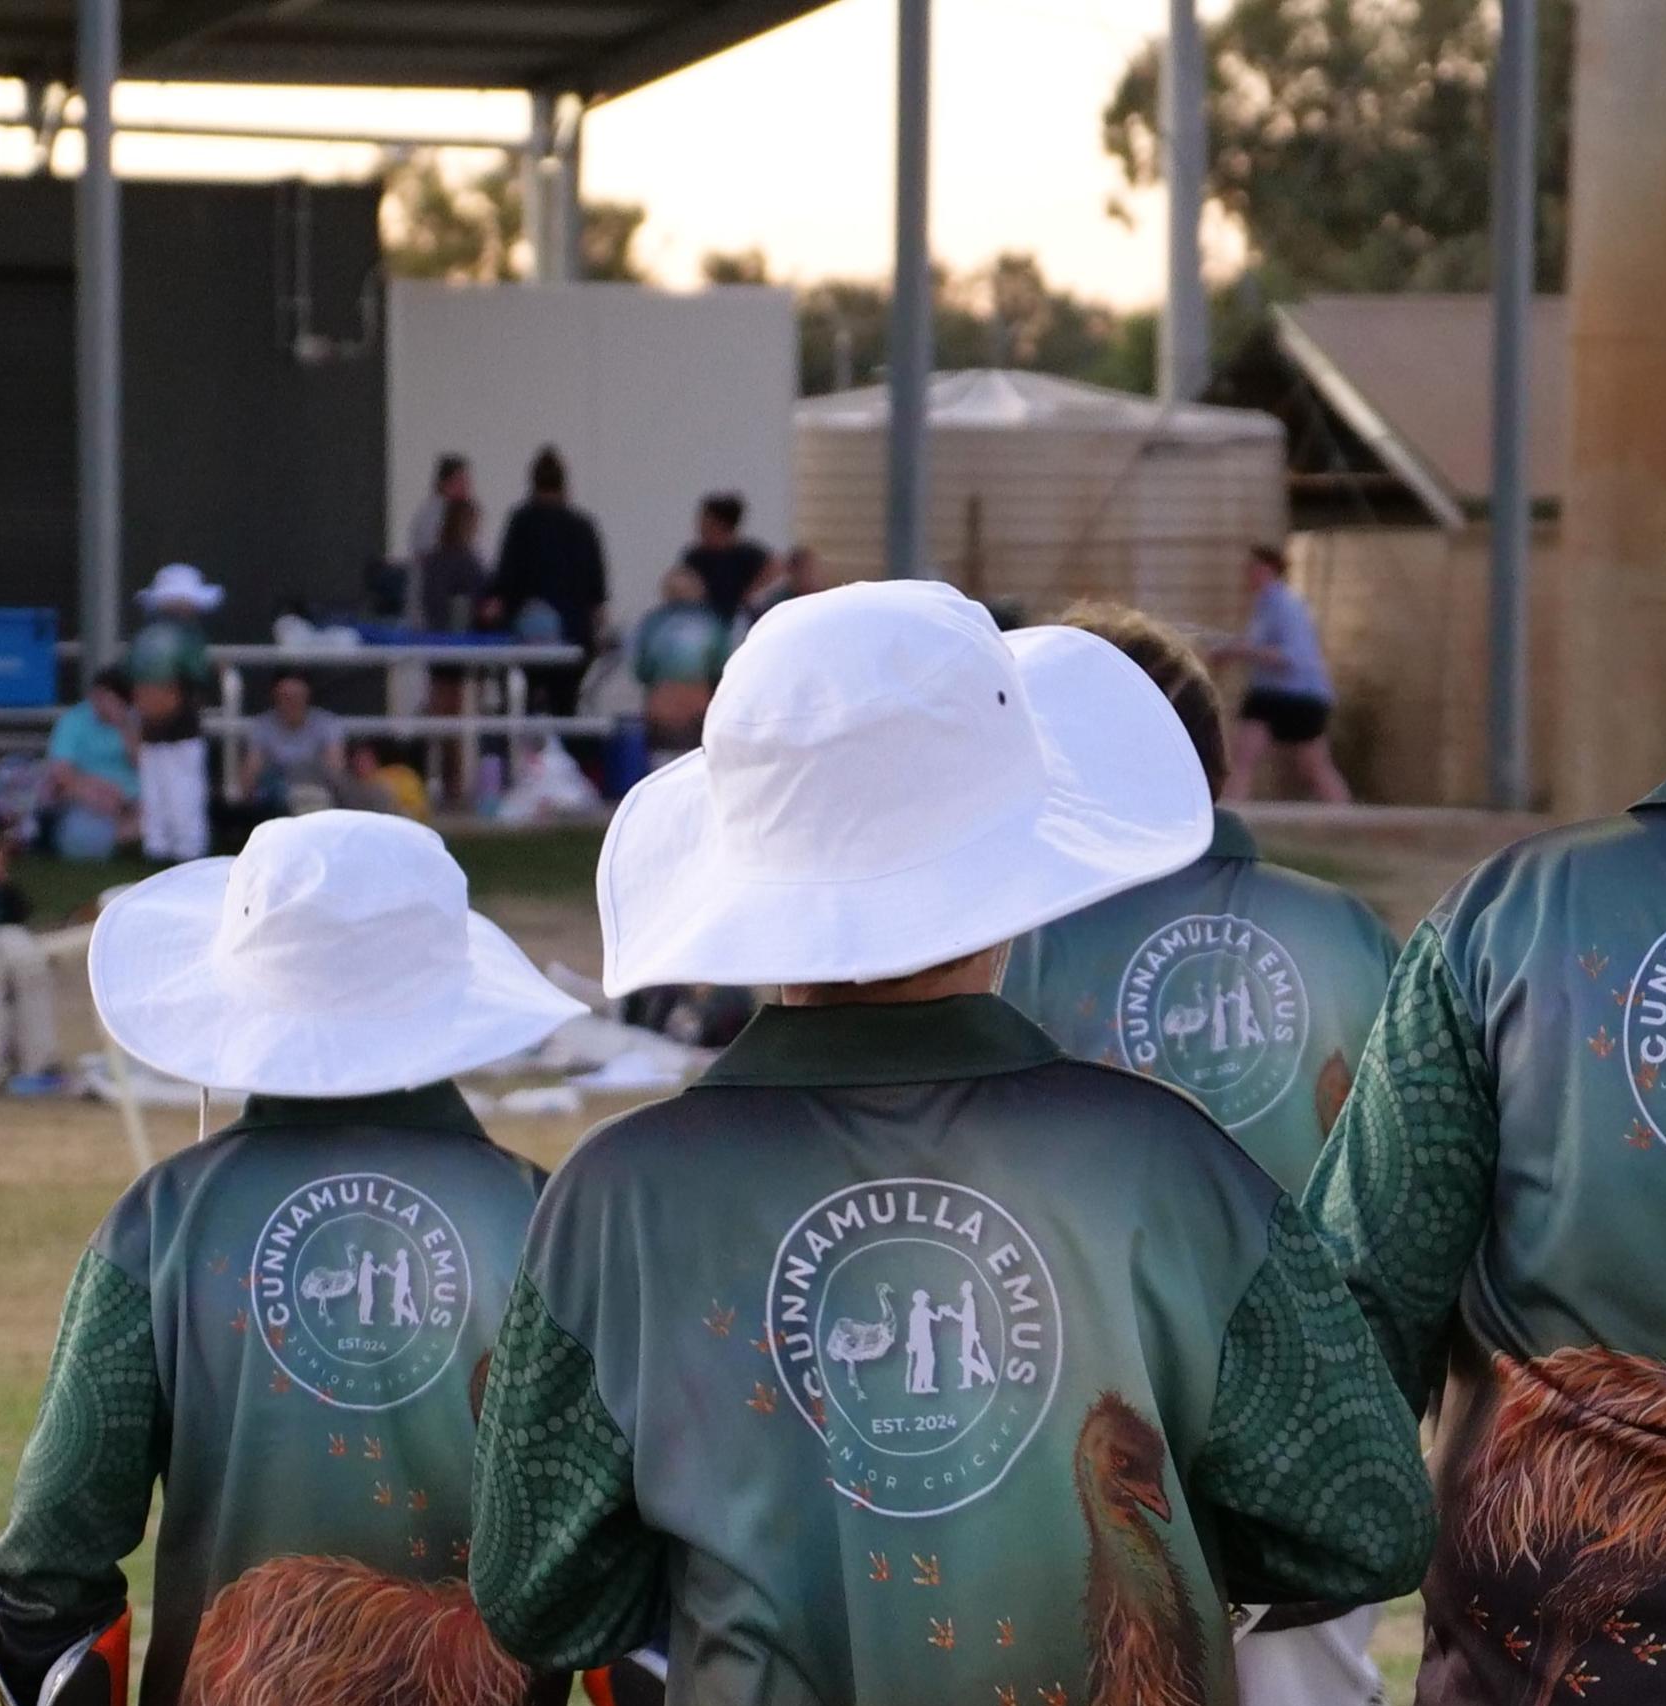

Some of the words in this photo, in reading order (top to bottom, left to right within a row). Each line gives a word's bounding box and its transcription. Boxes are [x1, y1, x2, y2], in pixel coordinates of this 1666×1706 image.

[1127, 922, 1252, 1062] CUNNAMULLA
[1257, 951, 1295, 1042] EMUS
[263, 1182, 421, 1326] CUNNAMULLA
[423, 1228, 456, 1328] EMUS
[781, 1192, 983, 1398] CUNNAMULLA
[987, 1243, 1041, 1385] EMUS
[872, 1418, 909, 1434] EST.
[915, 1415, 957, 1431] 2024
[923, 1405, 1019, 1491] CRICKET
